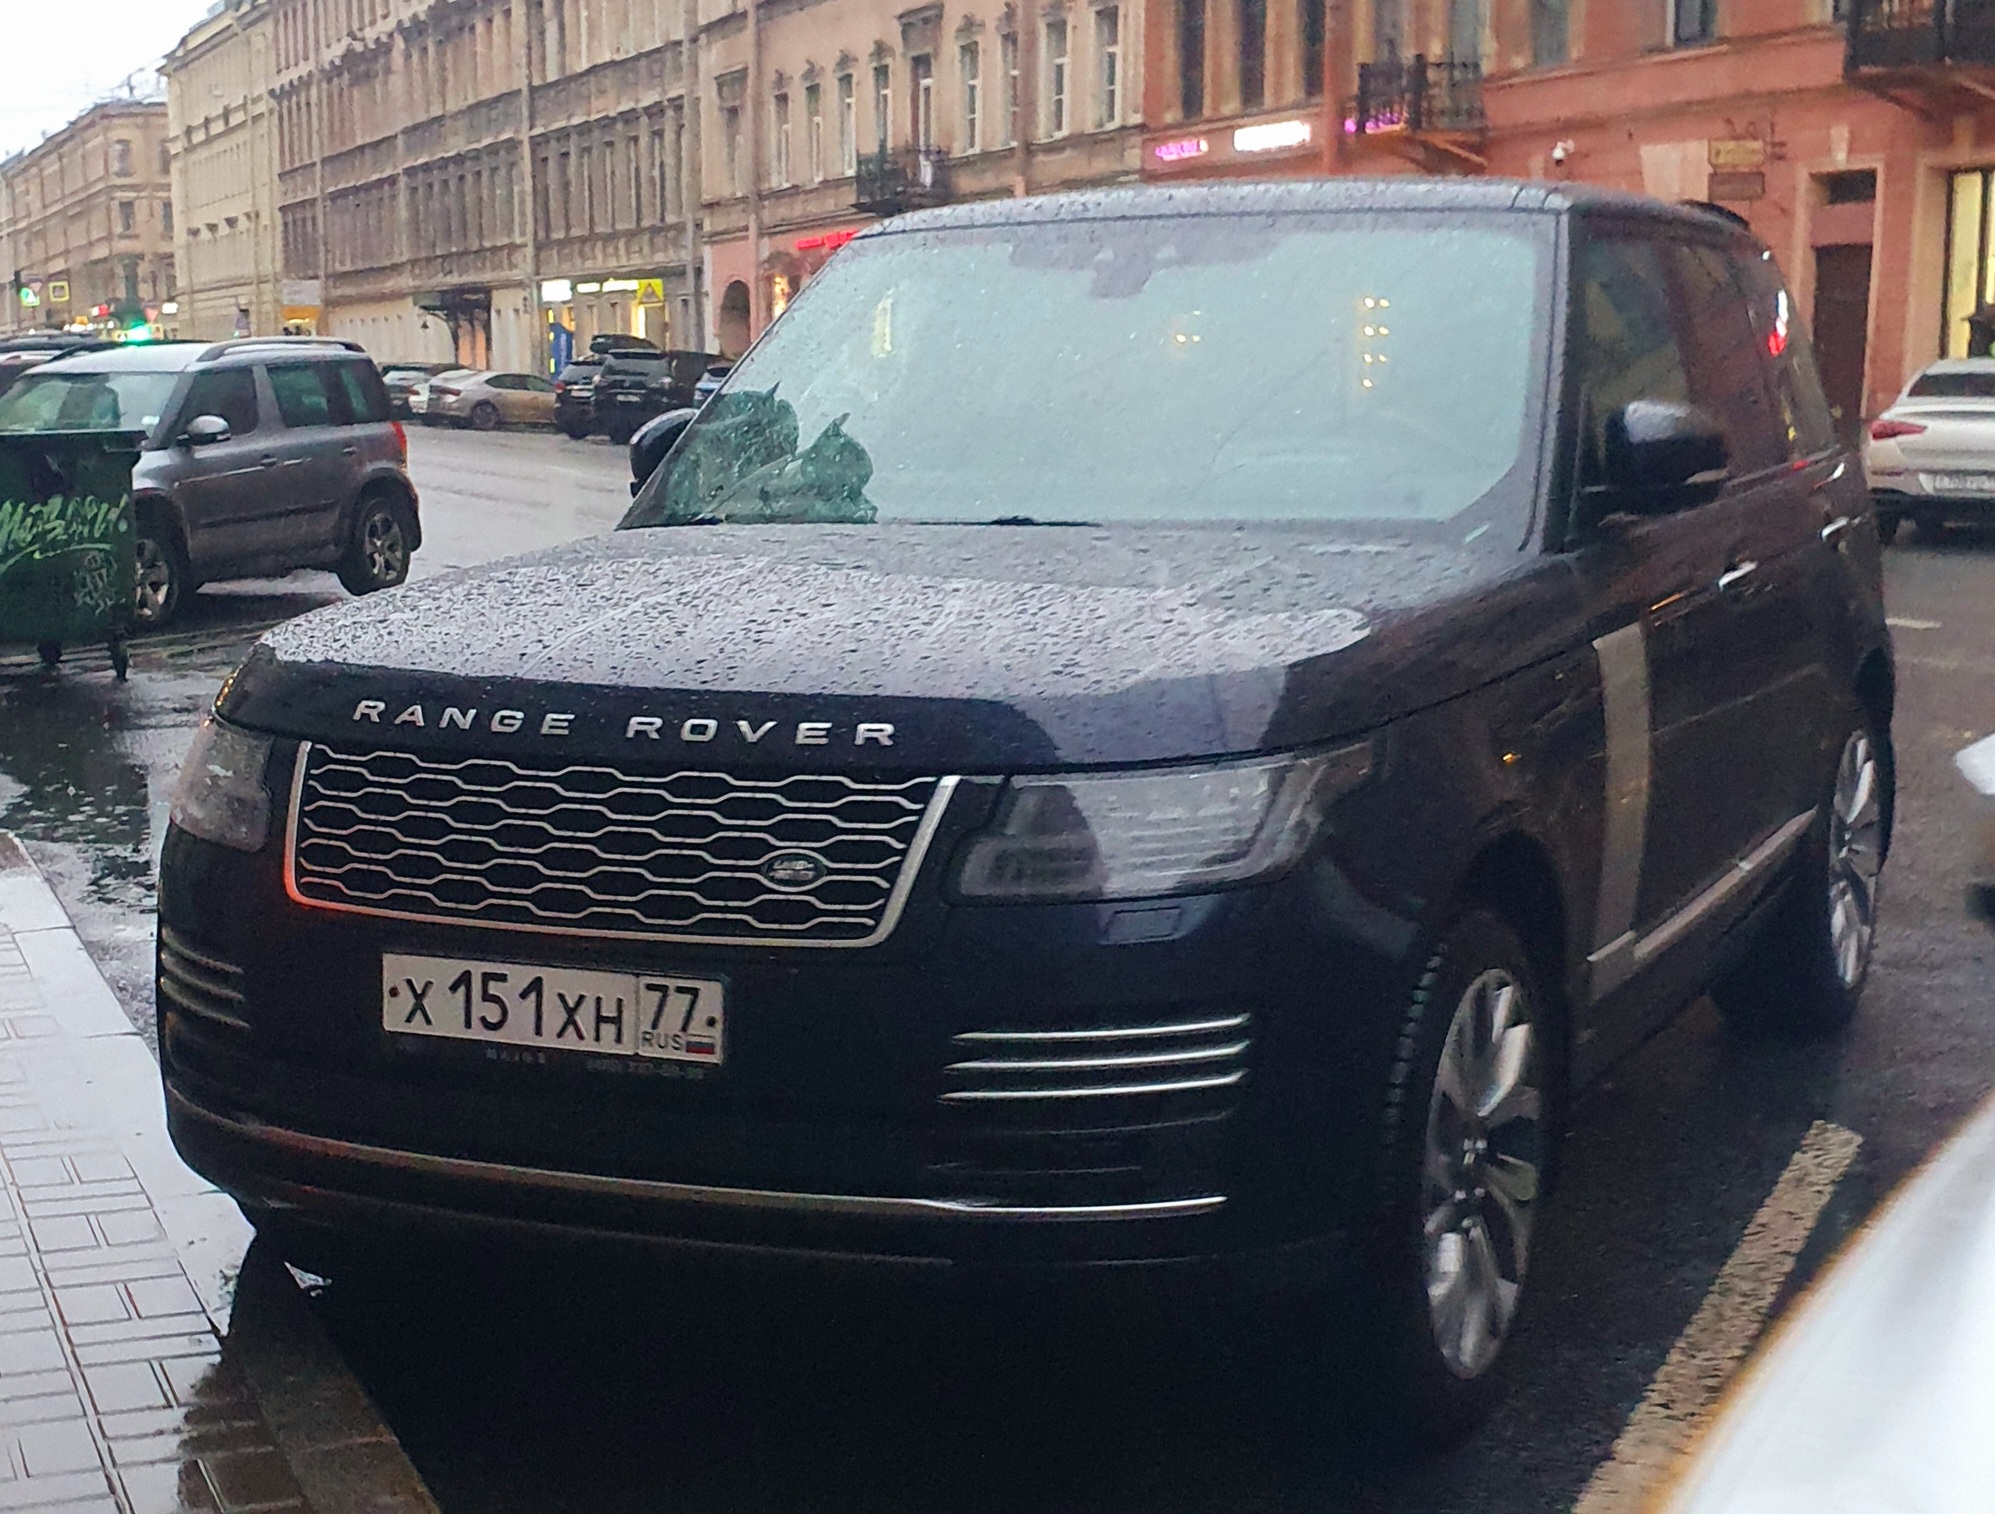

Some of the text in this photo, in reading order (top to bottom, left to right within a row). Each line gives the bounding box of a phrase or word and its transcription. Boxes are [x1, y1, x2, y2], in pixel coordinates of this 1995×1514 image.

[353, 700, 895, 746] RANGE ROVER
[645, 983, 701, 1032] 77
[641, 1030, 683, 1050] RUS
